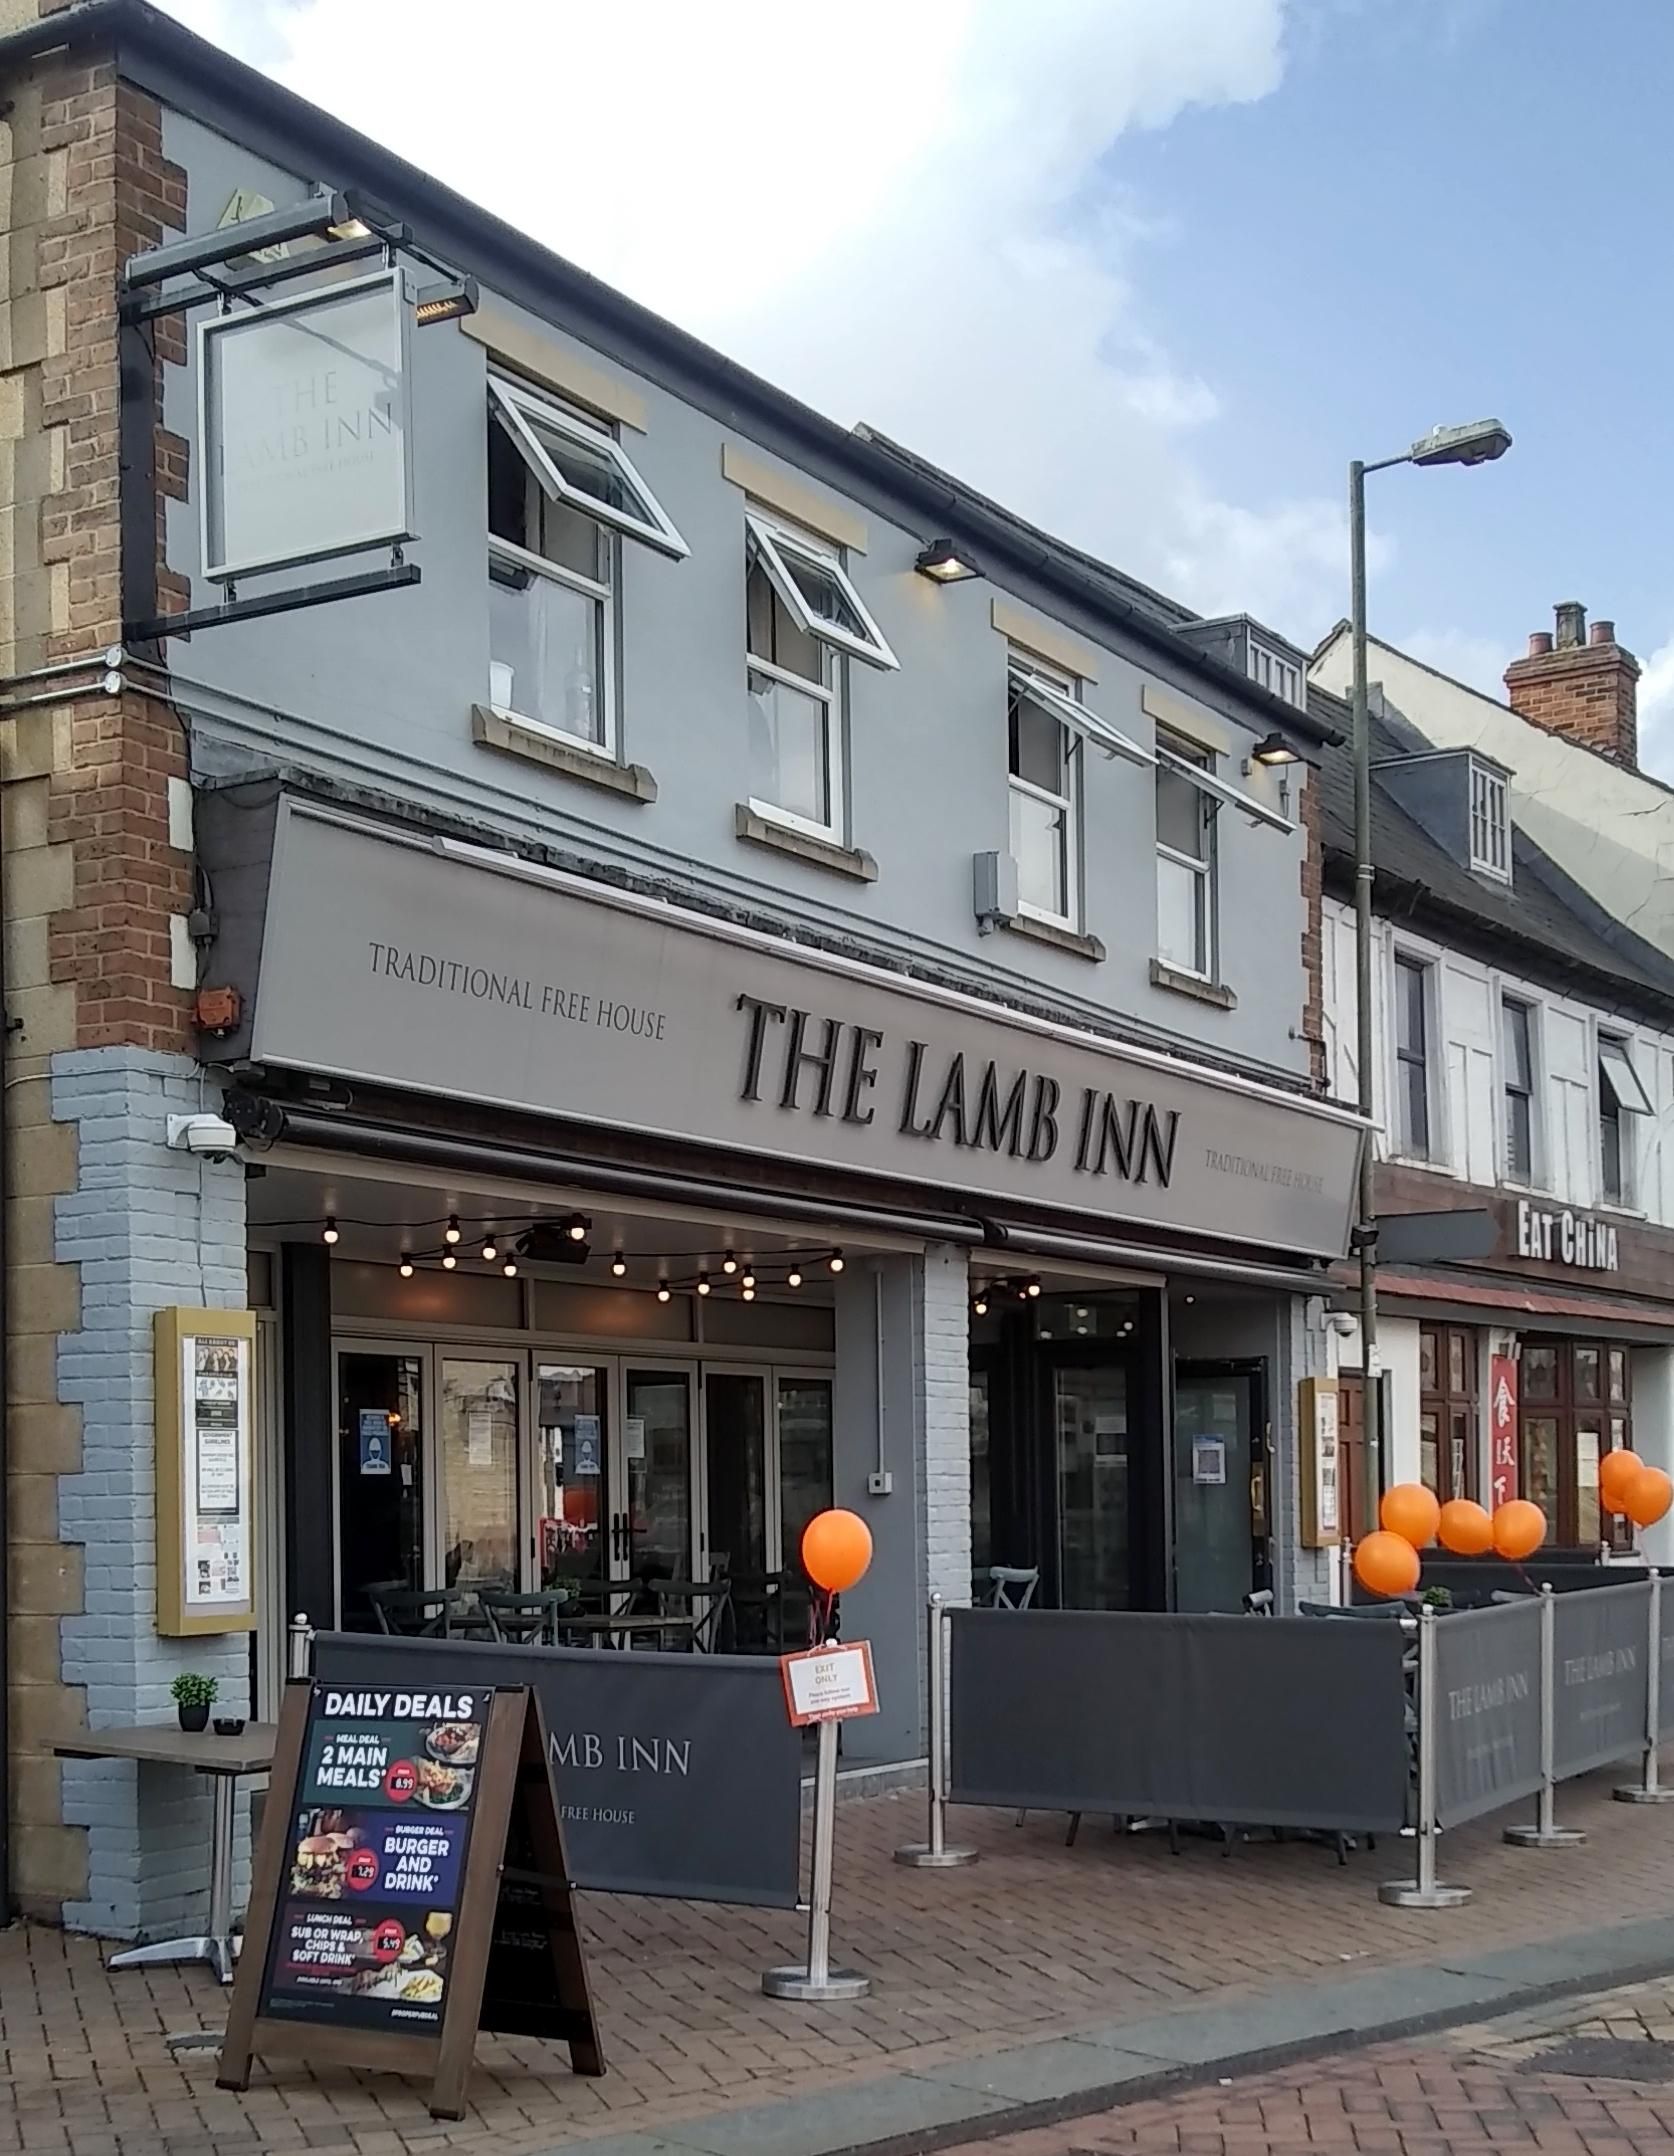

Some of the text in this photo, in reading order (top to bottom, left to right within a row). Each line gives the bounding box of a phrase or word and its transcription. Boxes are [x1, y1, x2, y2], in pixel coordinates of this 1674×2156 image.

[324, 402, 393, 450] INN
[369, 942, 666, 1040] TRADITIONAL FREE HOUSE
[736, 993, 1183, 1189] THE LAMB INN
[1206, 1149, 1269, 1183] TRADITIONAL
[1270, 1165, 1293, 1187] FREE
[1518, 1200, 1552, 1260] EAT
[815, 1662, 835, 1674] EXIT
[815, 1674, 837, 1685] ONLY
[324, 1692, 473, 1719] DAILY DEALS
[336, 1734, 380, 1745] MEAL DEAL
[321, 1745, 388, 1767] 2 MAIN
[549, 1732, 691, 1776] MB INN
[561, 1804, 636, 1825] FREE HOUSE
[395, 1825, 444, 1836] BURGER DEAL
[384, 1837, 450, 1857] BURGER
[395, 1855, 432, 1873] AND
[306, 1913, 352, 1926] LUNCH DEAL
[291, 1926, 364, 1944] SUB OR WRAP,
[292, 1948, 320, 1963] SOFT
[304, 1939, 346, 1952] CHIPS &
